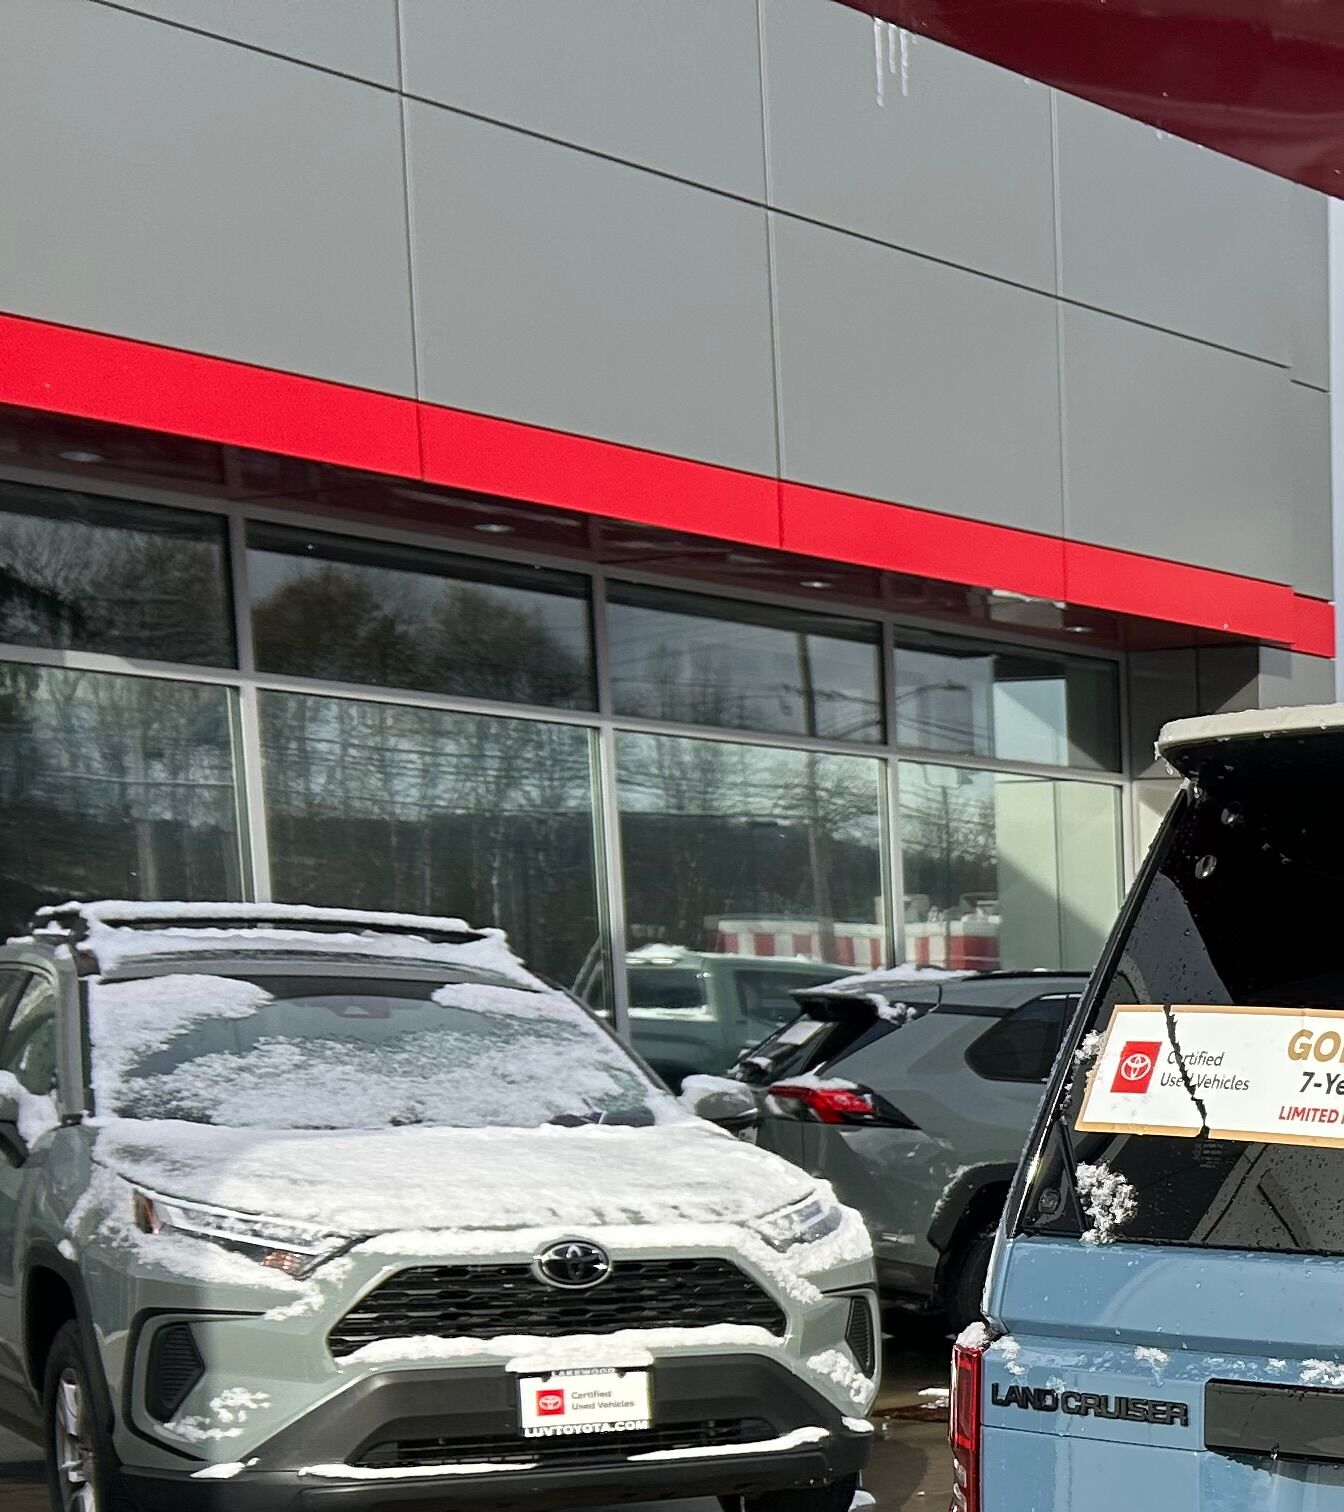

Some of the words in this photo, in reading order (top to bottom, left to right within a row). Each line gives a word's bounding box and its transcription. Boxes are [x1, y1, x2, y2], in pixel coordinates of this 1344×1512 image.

[1167, 1050, 1226, 1067] Crtified
[1197, 1073, 1251, 1091] Vehicles
[1278, 1106, 1340, 1124] LIMITED
[551, 1367, 617, 1377] LAKEWOOD
[571, 1389, 612, 1400] Certified
[572, 1401, 596, 1411] Used
[991, 1383, 1059, 1412] LAND
[1061, 1391, 1189, 1427] CRUISER
[524, 1419, 650, 1438] LUVTOYOTA.COM
